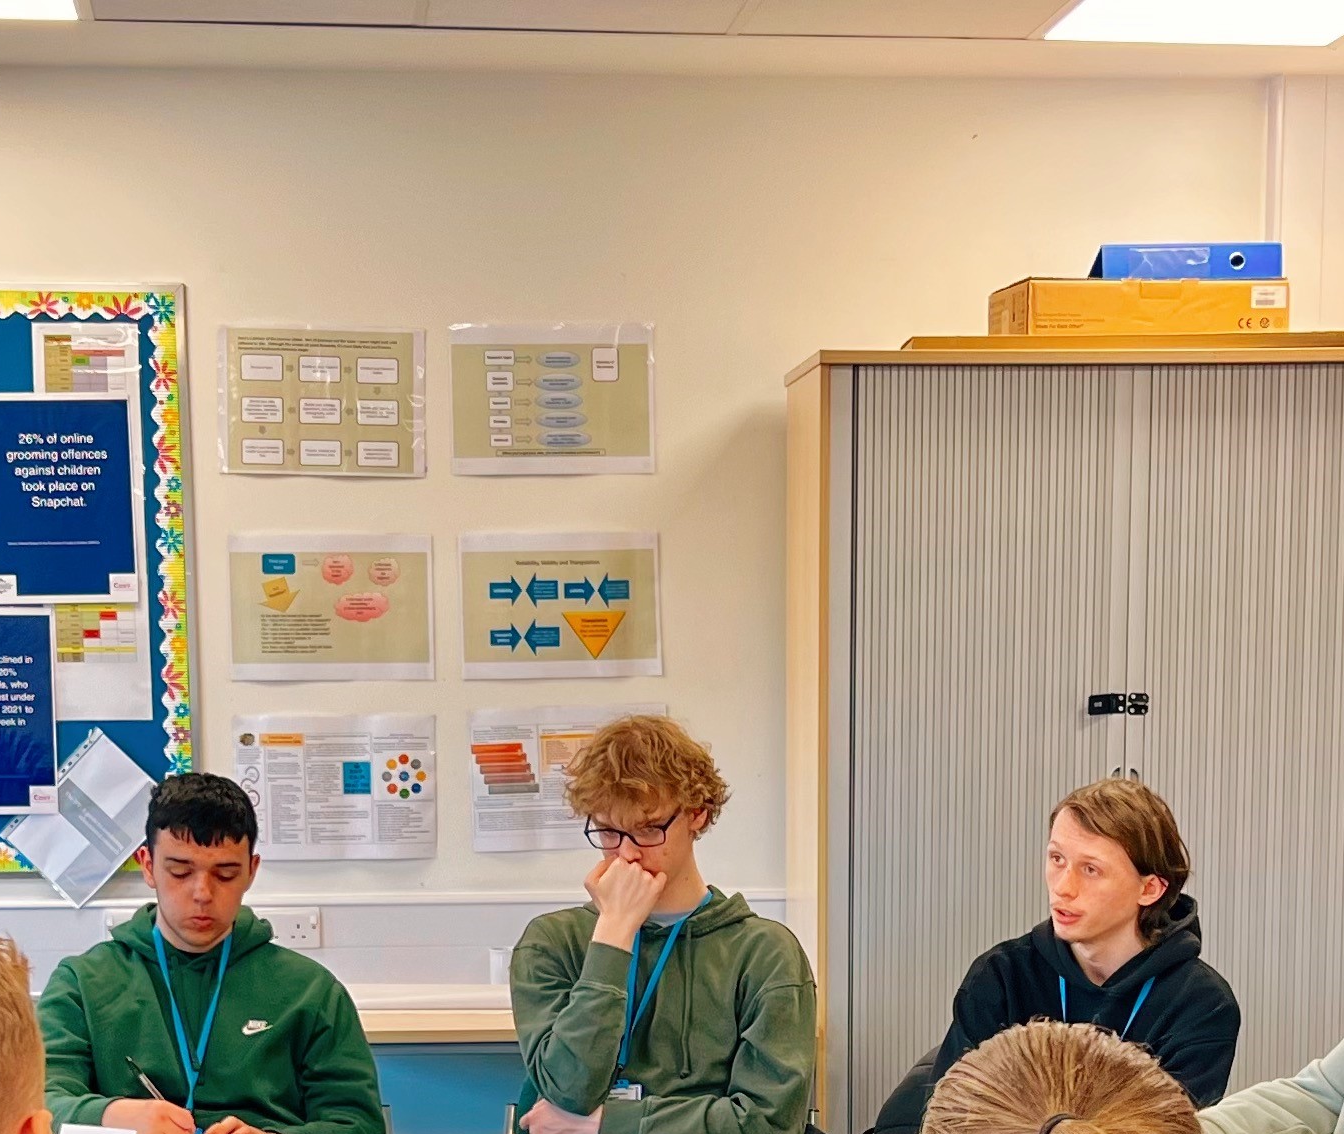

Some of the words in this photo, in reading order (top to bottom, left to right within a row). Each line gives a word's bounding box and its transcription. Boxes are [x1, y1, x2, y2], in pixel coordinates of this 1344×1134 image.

[18, 433, 44, 444] 26%
[46, 433, 57, 444] of
[60, 433, 94, 444] online
[6, 449, 58, 463] grooming
[61, 449, 108, 460] offences
[14, 465, 55, 478] against
[57, 464, 101, 476] children
[21, 480, 46, 491] took
[48, 480, 78, 493] place
[81, 482, 95, 491] on
[31, 495, 87, 509] Snapchat.
[24, 655, 33, 664] in
[10, 680, 28, 689] who
[10, 693, 35, 701] under
[2, 706, 22, 714] 2021
[24, 706, 34, 714] to
[17, 718, 26, 726] in
